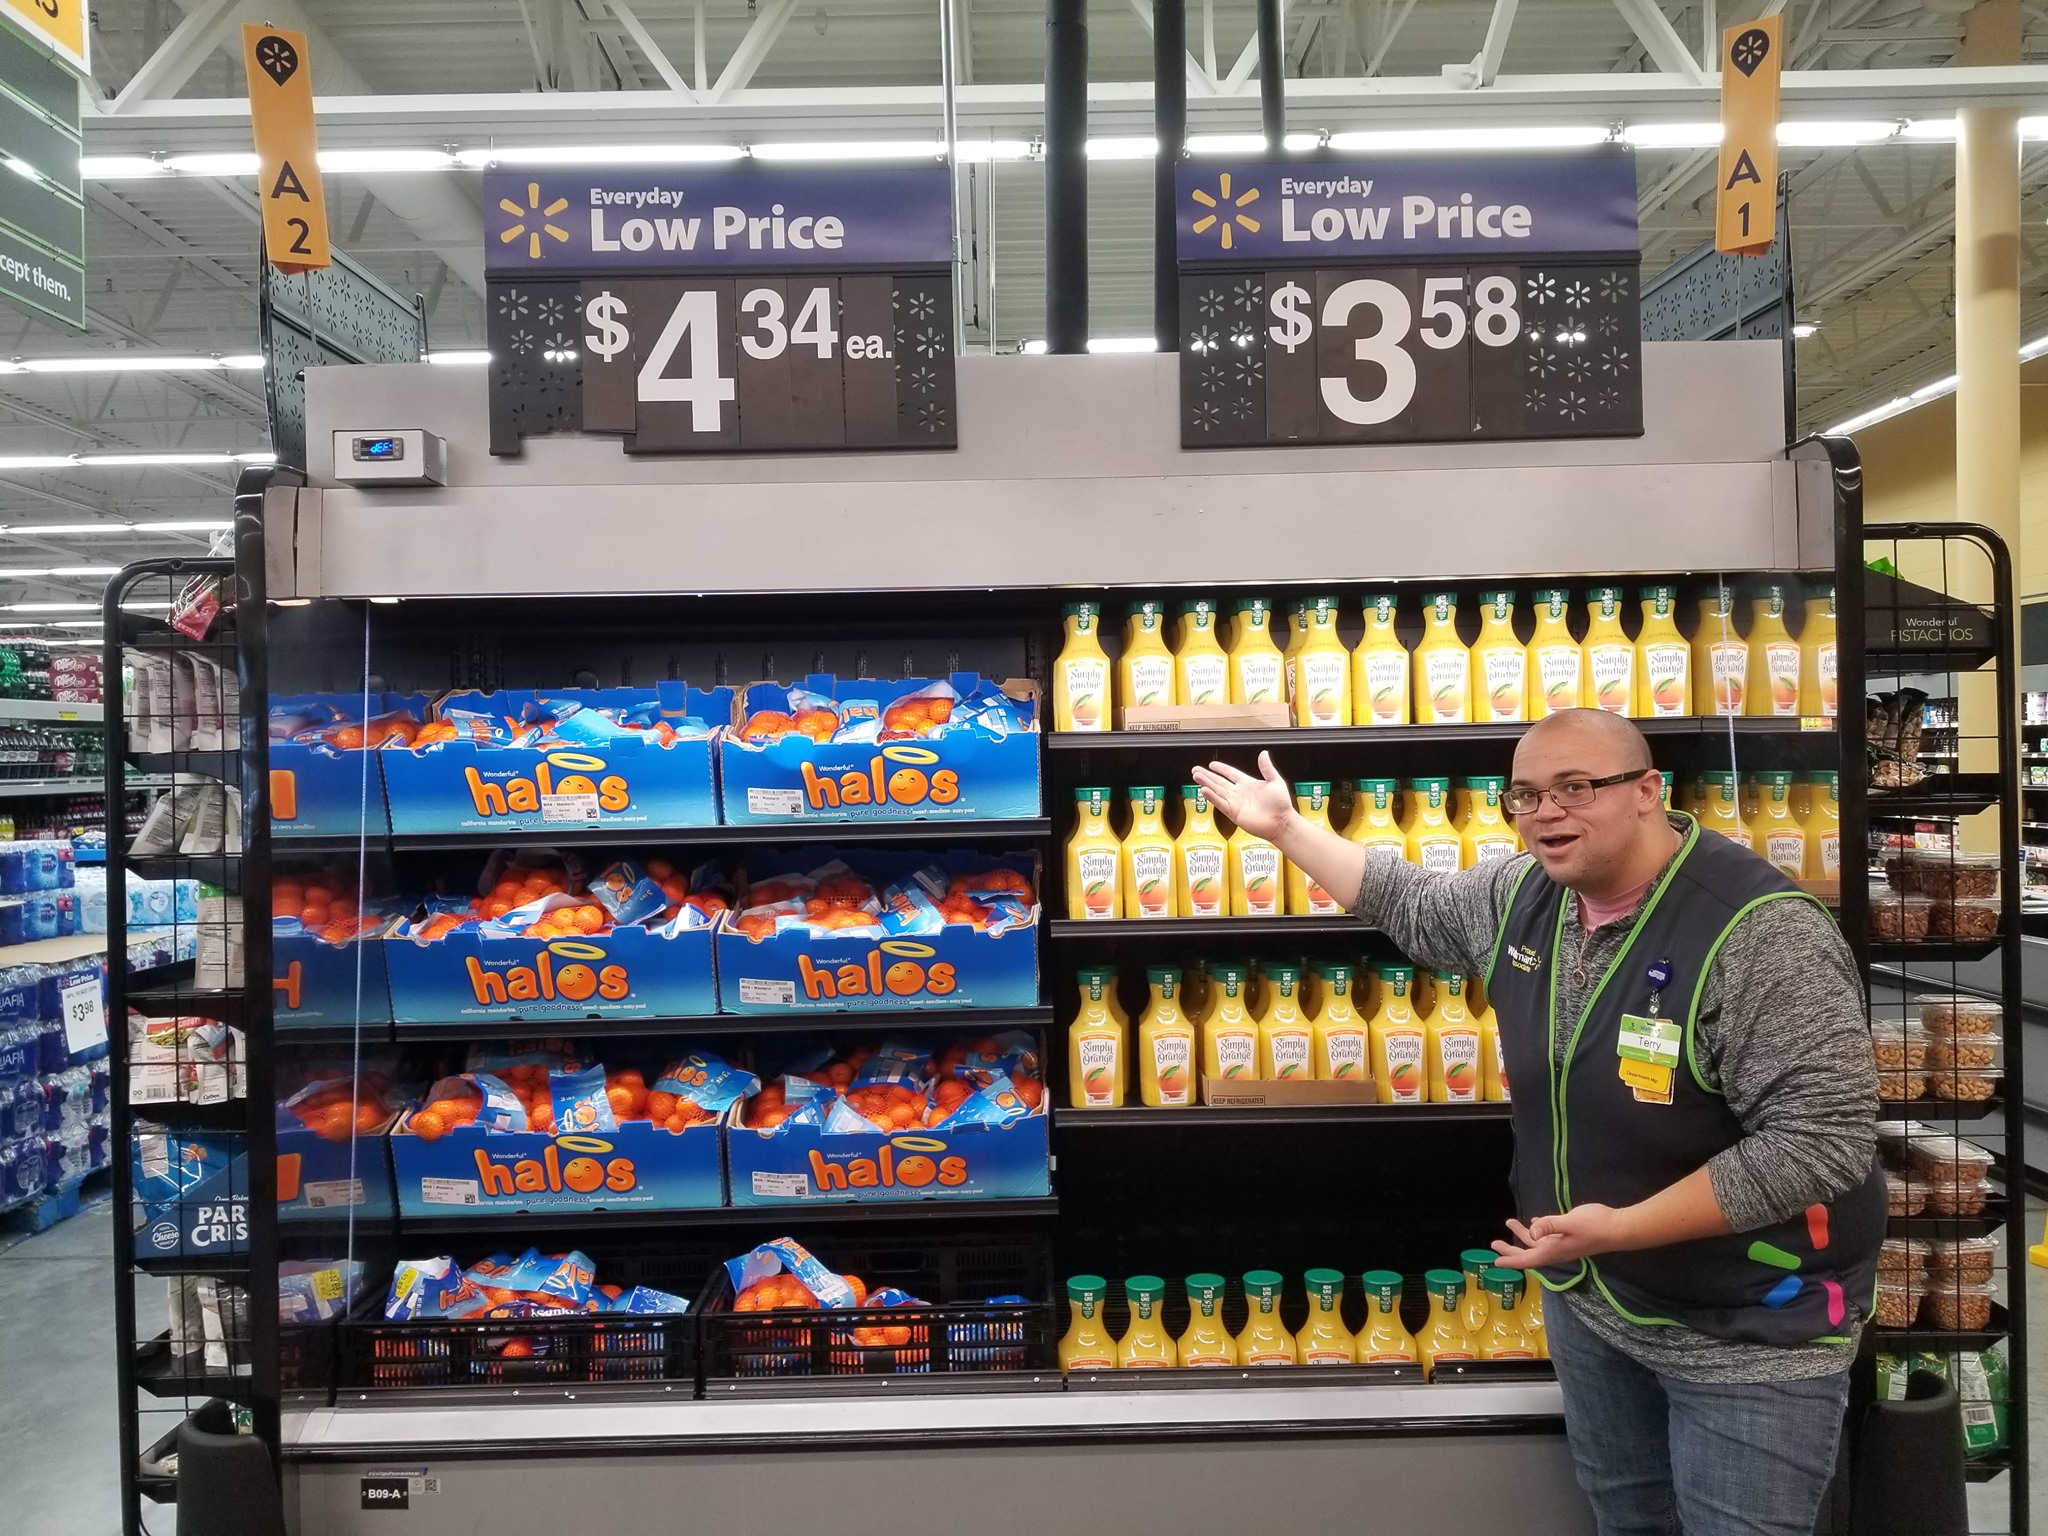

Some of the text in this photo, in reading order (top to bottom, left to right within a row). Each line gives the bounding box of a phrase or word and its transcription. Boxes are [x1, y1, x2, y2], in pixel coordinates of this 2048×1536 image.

[1725, 148, 1762, 191] A
[270, 160, 311, 203] A
[1281, 176, 1373, 198] Everyday
[590, 187, 684, 209] Everyday
[1282, 192, 1532, 243] Low Price
[1738, 202, 1750, 237] 1
[590, 204, 845, 252] Low Price
[286, 217, 312, 255] 2
[32, 266, 72, 302] them.
[846, 334, 893, 360] ea.
[1905, 617, 1958, 627] Wonderul
[1652, 652, 1684, 666] Simply
[800, 755, 960, 809] halos
[464, 761, 630, 817] halos
[850, 808, 911, 818] pure goodness
[519, 818, 538, 827] pure
[1190, 852, 1220, 865] Simply
[1245, 851, 1275, 864] Simply
[1426, 846, 1456, 859] Simply
[1083, 855, 1112, 868] Simply
[1137, 854, 1167, 867] Simply
[1425, 857, 1456, 869] Orange
[1083, 866, 1113, 879] Orange
[1137, 865, 1167, 878] Orange
[1190, 863, 1220, 876] Orange
[1245, 862, 1275, 874] Orange
[484, 959, 518, 967] Wonderful
[81, 973, 94, 982] Price
[465, 950, 629, 1006] halos
[797, 949, 956, 1000] halos
[519, 1003, 580, 1014] pure goodness
[847, 998, 907, 1008] pure goodness
[1083, 1041, 1113, 1054] Simply
[1158, 1040, 1188, 1053] Simply
[1220, 1038, 1251, 1051] Simply
[1276, 1037, 1306, 1051] Simply
[1331, 1037, 1362, 1050] Simply
[1390, 1037, 1420, 1051] Simply
[1445, 1036, 1475, 1050] Simply
[1638, 1036, 1661, 1051] Terry
[1083, 1053, 1113, 1065] Orange
[1157, 1051, 1187, 1064] Orange
[1220, 1050, 1251, 1062] Orange
[1275, 1049, 1306, 1062] Orange
[1331, 1048, 1361, 1061] Orange
[1389, 1050, 1420, 1062] Orange
[1444, 1049, 1475, 1061] Orange
[473, 1144, 636, 1196] halos
[808, 1144, 968, 1191] halos
[858, 1189, 918, 1199] pure goodness
[526, 1196, 587, 1206] pure goodness
[198, 1205, 246, 1225] PAR
[152, 1230, 180, 1243] Cheese
[191, 1223, 248, 1247] CRIS
[368, 1489, 401, 1499] B09-A
